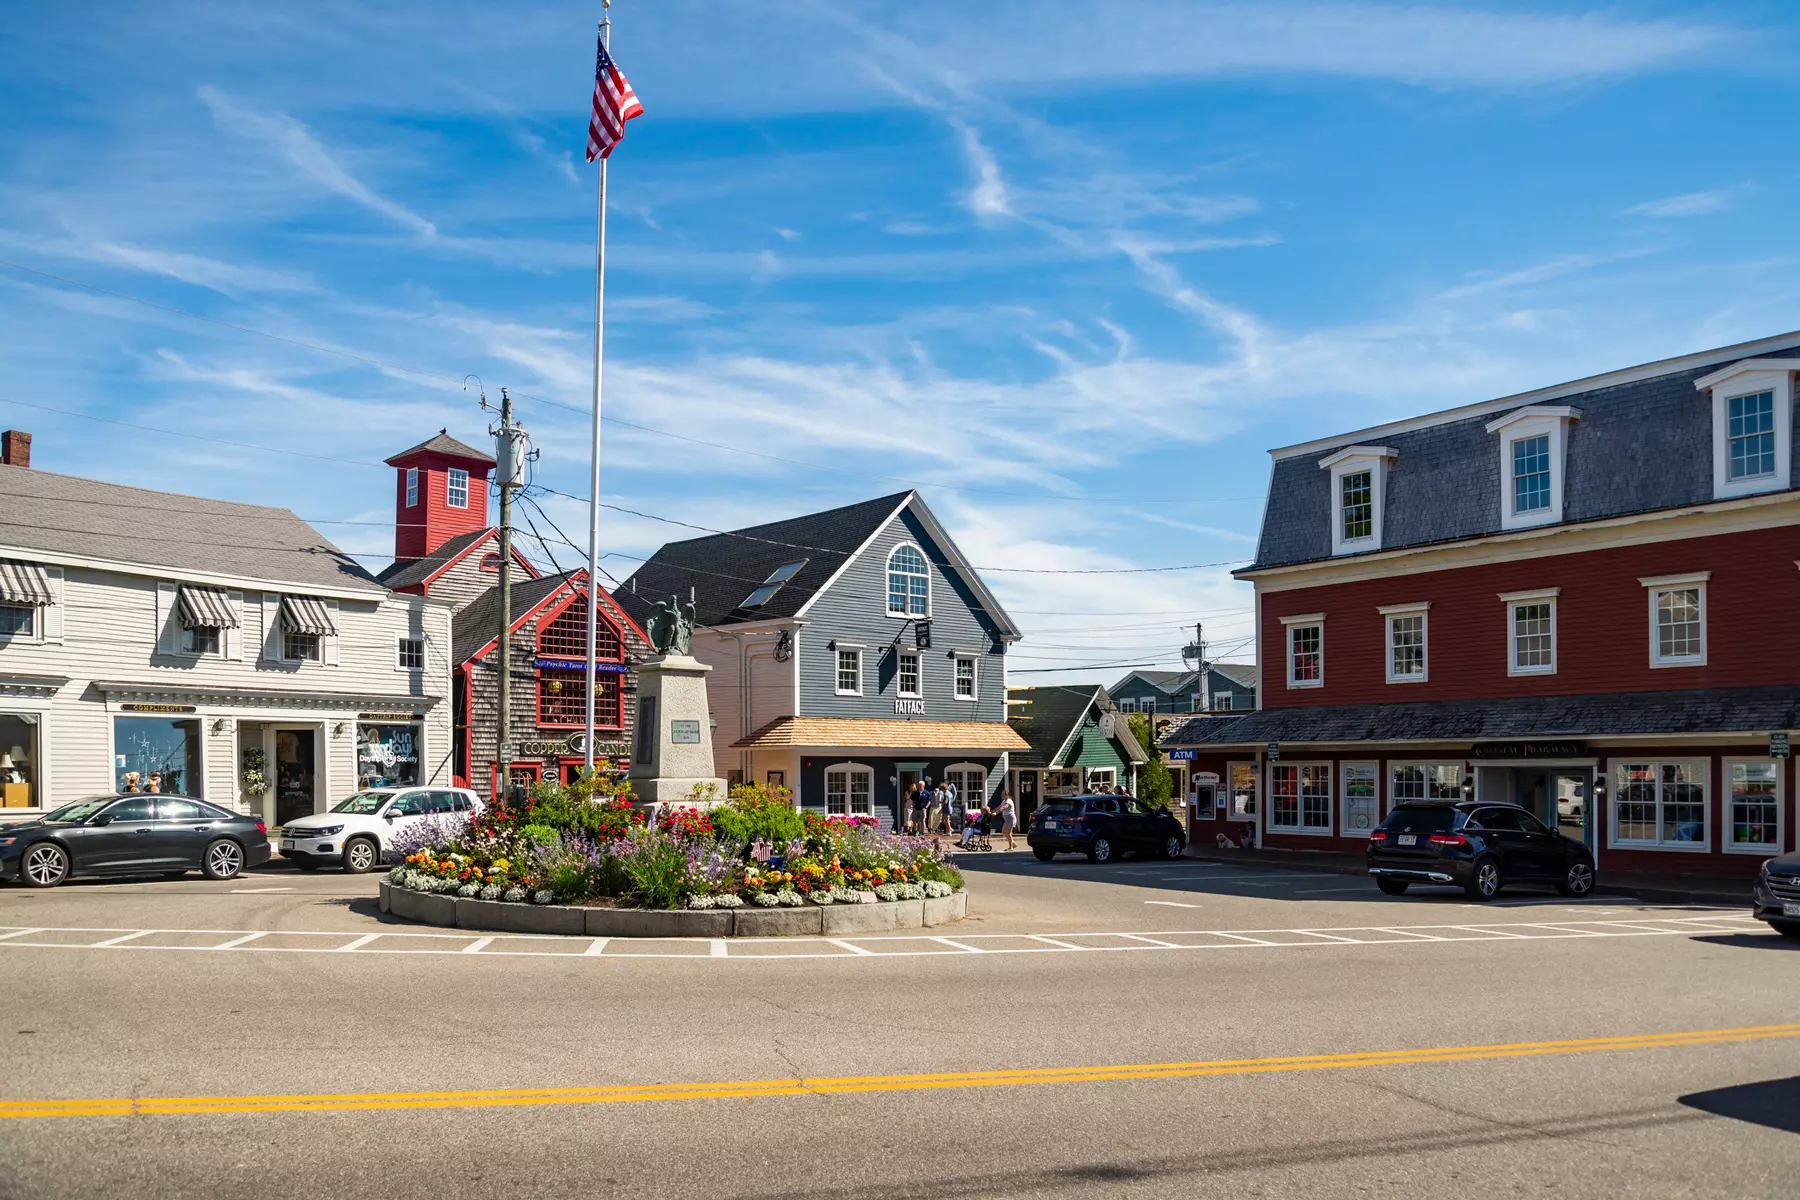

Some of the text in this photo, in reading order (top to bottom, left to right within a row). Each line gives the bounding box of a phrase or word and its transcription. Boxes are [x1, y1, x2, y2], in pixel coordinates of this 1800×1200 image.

[545, 660, 567, 668] Psychic
[133, 704, 184, 712] COMPLIMENTS
[894, 699, 926, 715] FATFACE
[392, 730, 412, 744] Sun
[524, 742, 571, 755] COPPER
[1523, 743, 1578, 757] PHARMACY
[359, 754, 418, 763] Daytrip Society
[1174, 751, 1193, 759] ATM
